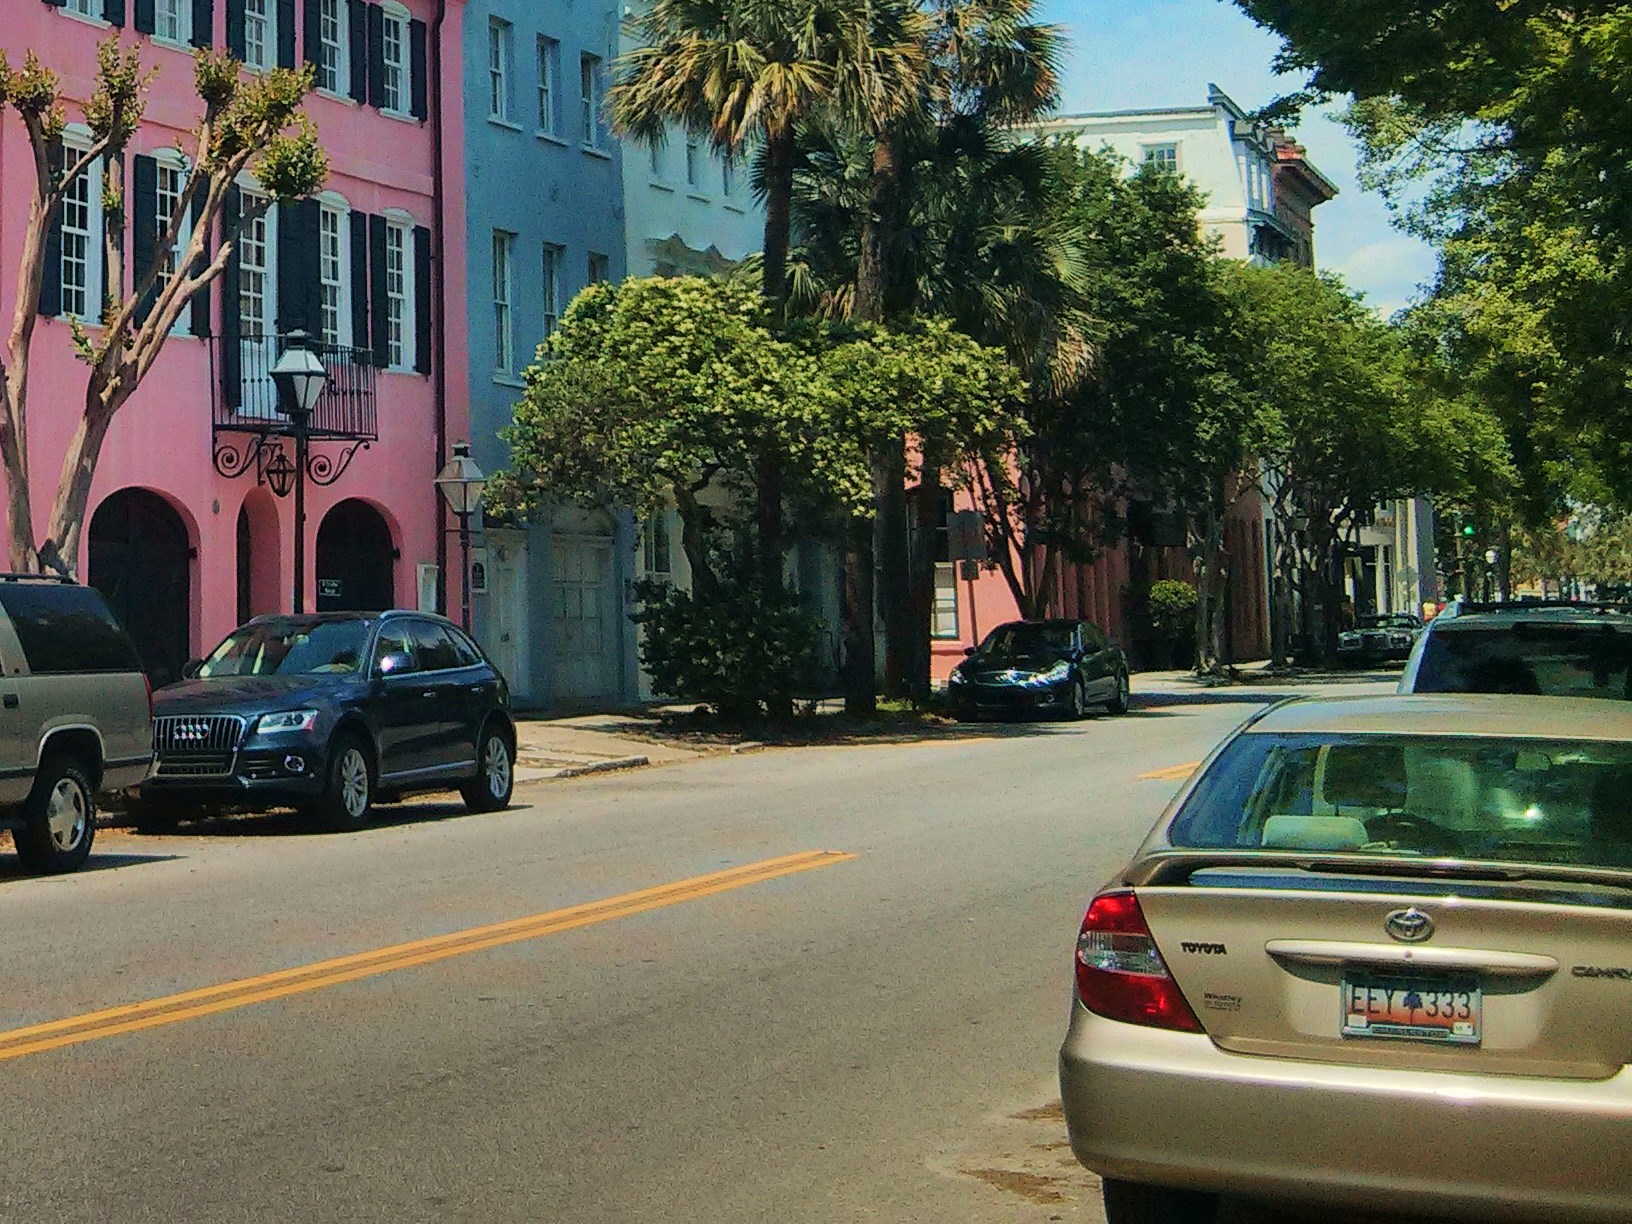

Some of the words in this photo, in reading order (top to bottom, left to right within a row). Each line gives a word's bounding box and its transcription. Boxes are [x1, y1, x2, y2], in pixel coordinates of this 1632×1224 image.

[1180, 942, 1227, 955] TOYOTA
[1351, 986, 1394, 1014] EEY
[1425, 989, 1471, 1019] 333
